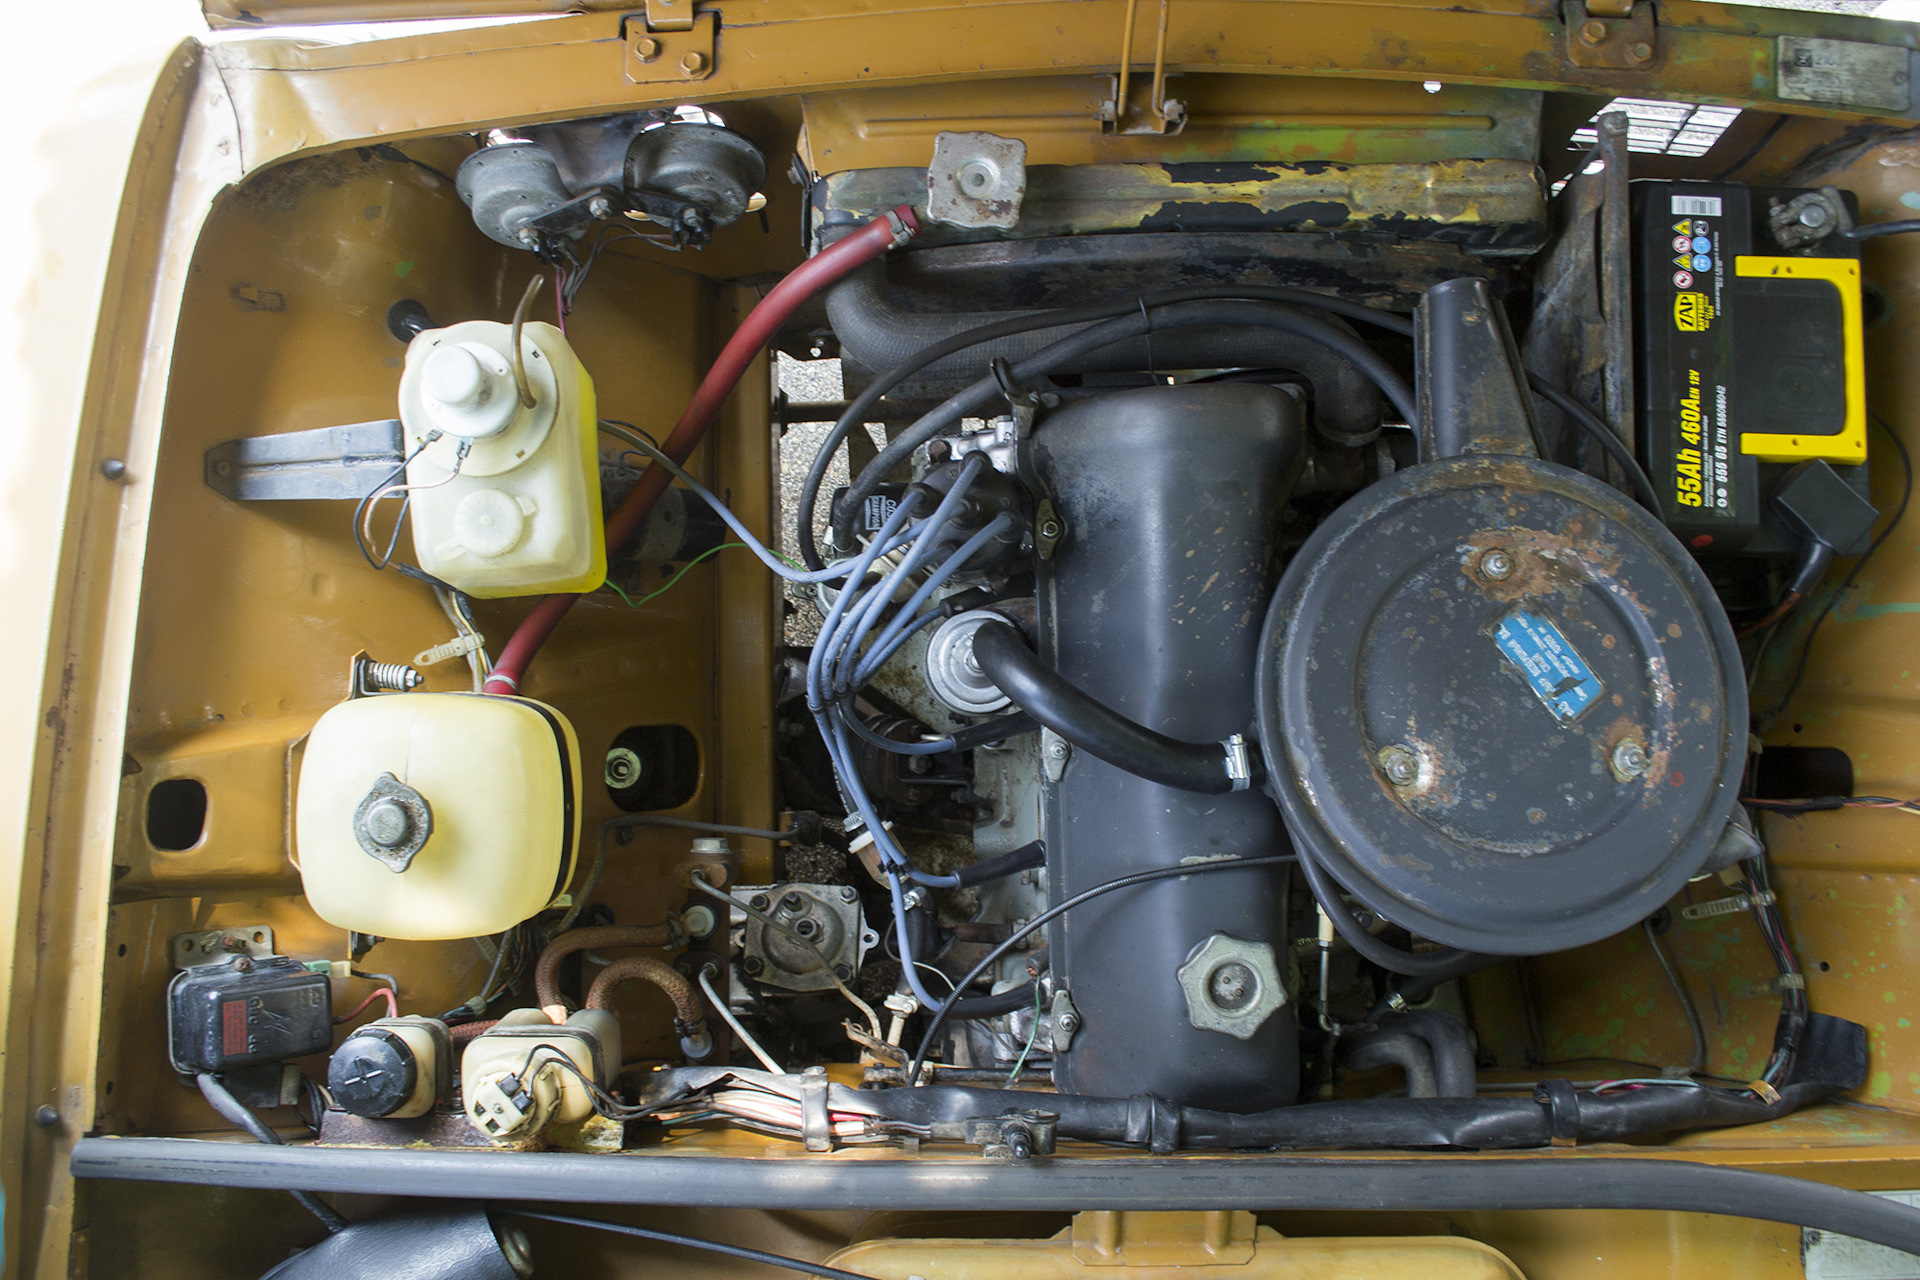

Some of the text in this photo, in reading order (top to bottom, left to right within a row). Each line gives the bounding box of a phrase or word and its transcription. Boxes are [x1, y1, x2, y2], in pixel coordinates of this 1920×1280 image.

[1678, 295, 1693, 328] ZAP
[1689, 369, 1700, 385] 12V
[1677, 447, 1702, 507] 55Ah
[871, 496, 880, 528] CHAMPION
